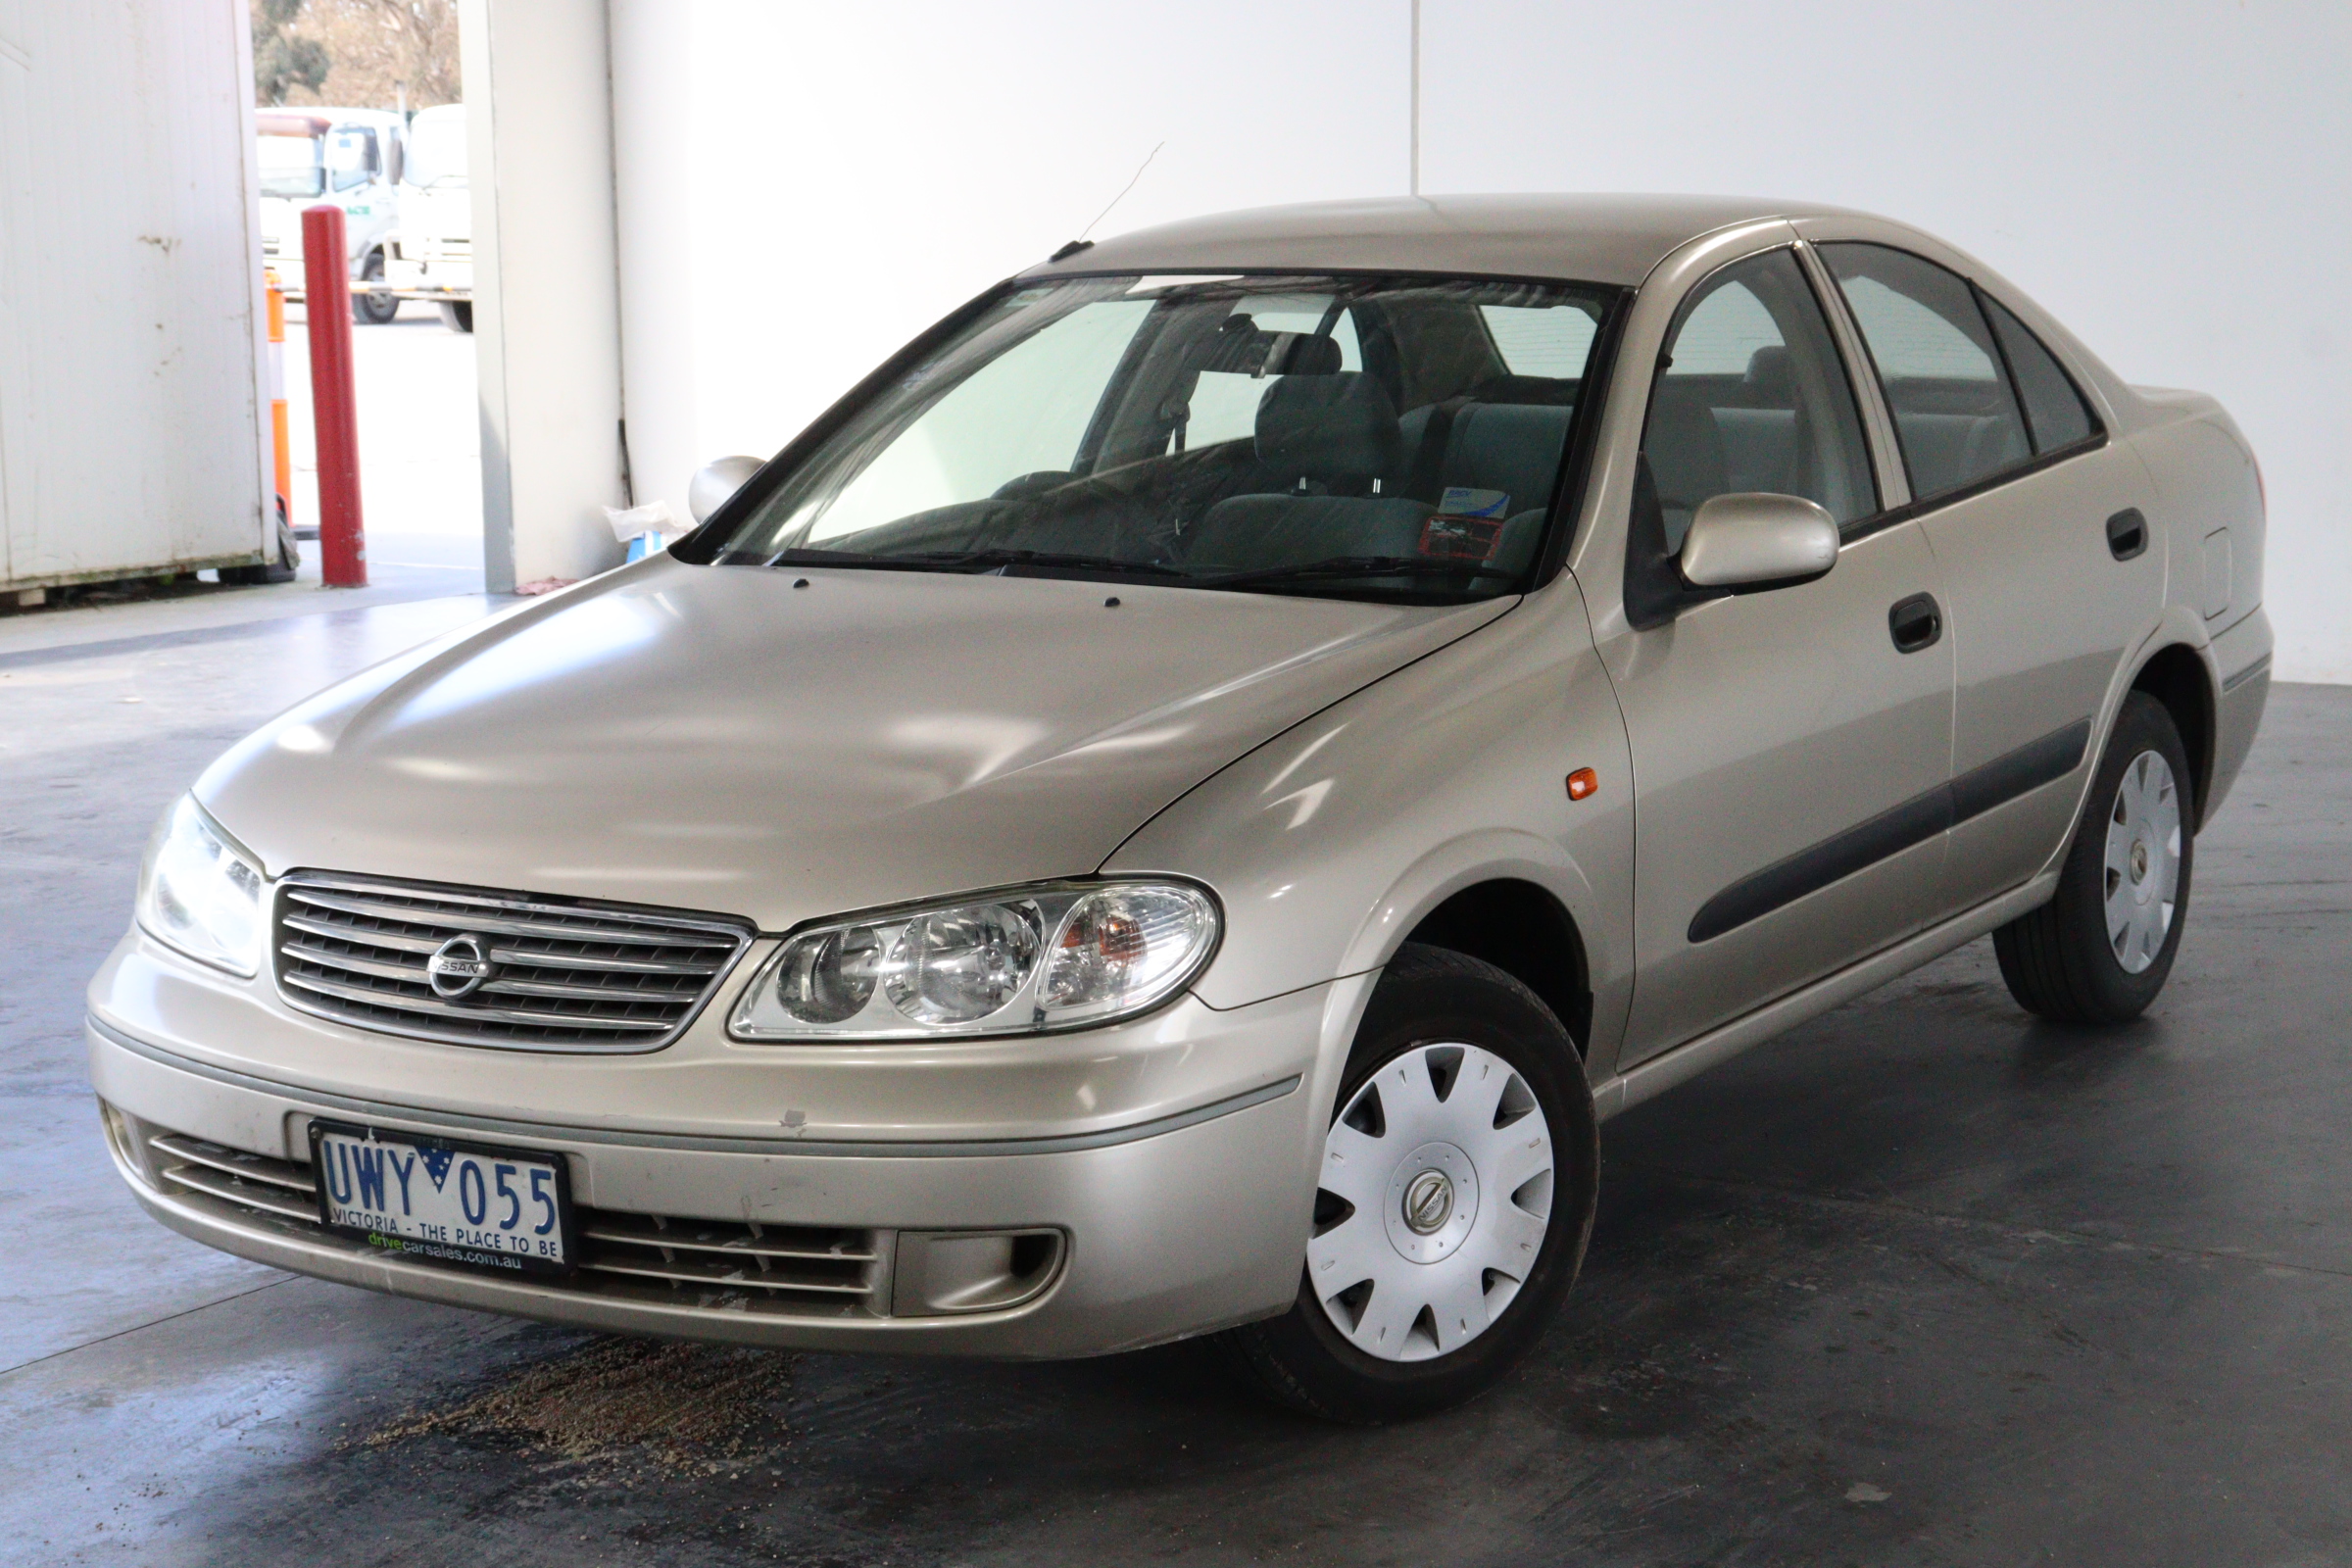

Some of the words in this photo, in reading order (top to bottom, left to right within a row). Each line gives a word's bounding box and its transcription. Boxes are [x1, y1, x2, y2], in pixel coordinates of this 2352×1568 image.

[432, 959, 478, 974] SSAN
[323, 1140, 415, 1216] UWY
[460, 1159, 556, 1236] 055
[1418, 1185, 1447, 1221] NISSAN
[332, 1207, 399, 1234] VICTORIA
[419, 1222, 448, 1242] THE
[457, 1228, 502, 1250] PLACE
[510, 1236, 530, 1252] TO
[539, 1240, 558, 1257] BE
[368, 1232, 522, 1270] drivecarsales.com.au
